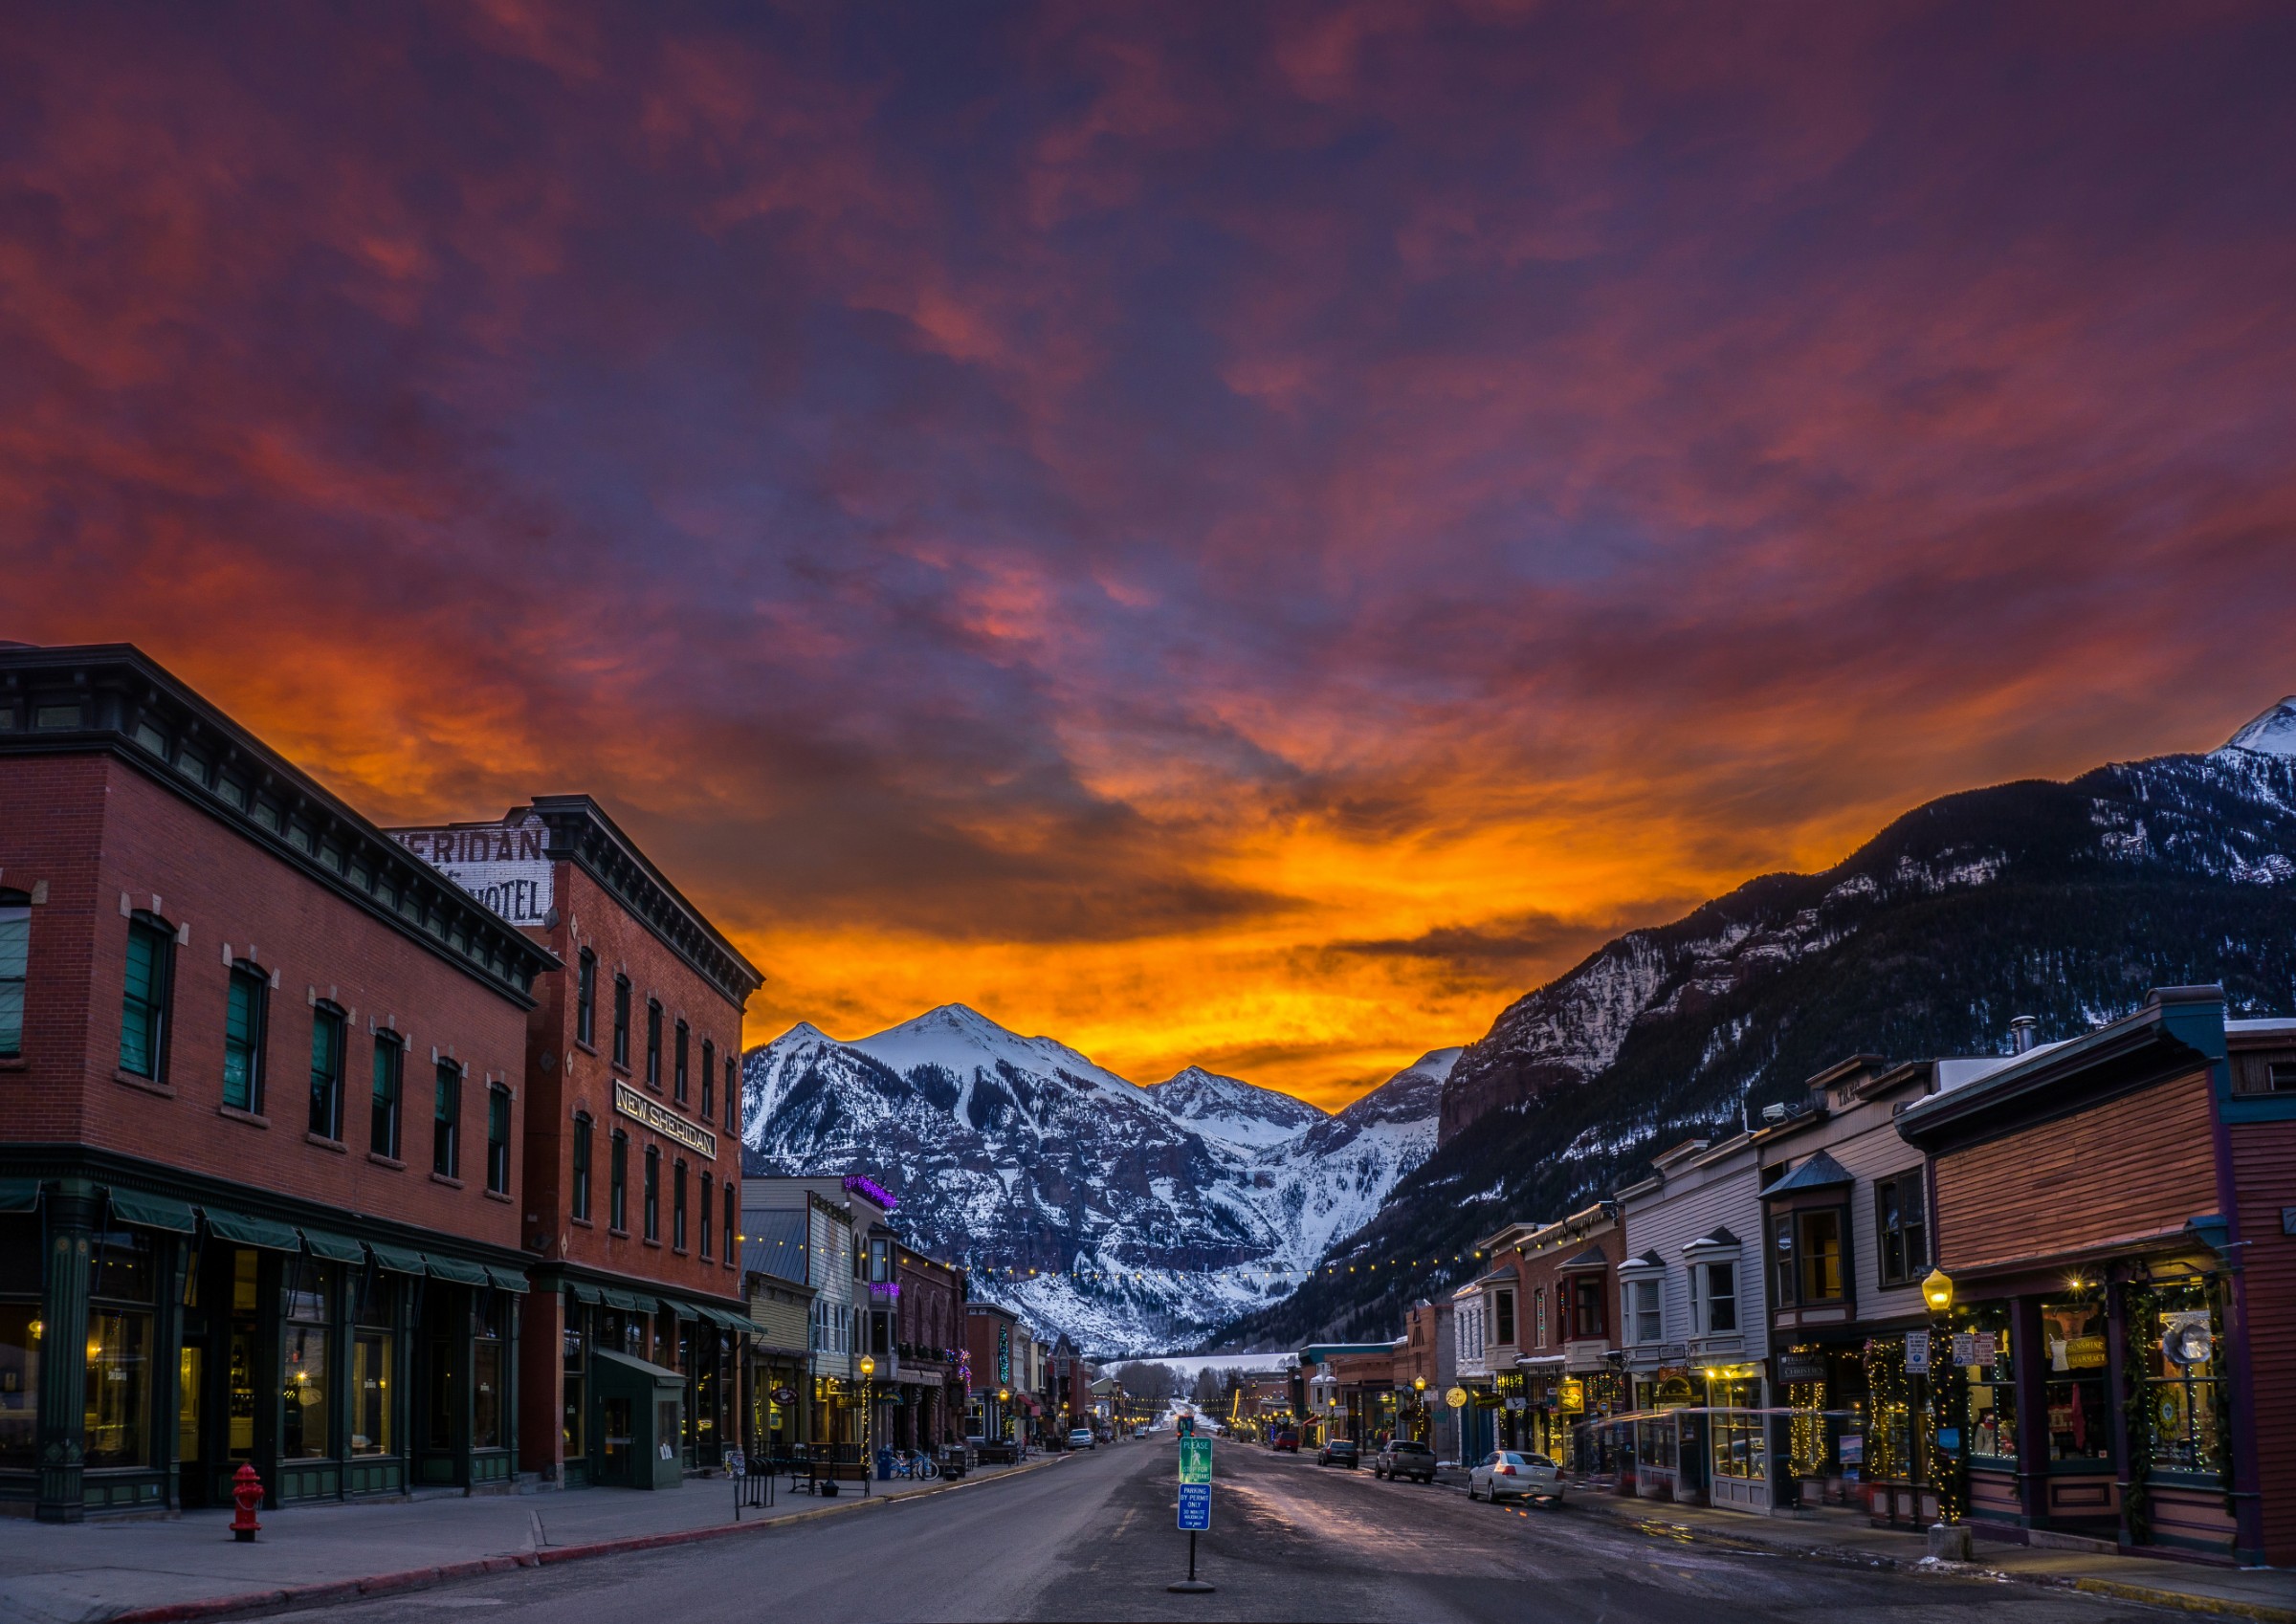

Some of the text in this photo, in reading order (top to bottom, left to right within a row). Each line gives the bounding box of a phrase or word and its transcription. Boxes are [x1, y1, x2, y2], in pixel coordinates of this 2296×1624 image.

[617, 1086, 712, 1154] NEW SHERIDAN
[2067, 1341, 2104, 1352] SUNSHINE
[1183, 1441, 1209, 1450] PLEASE
